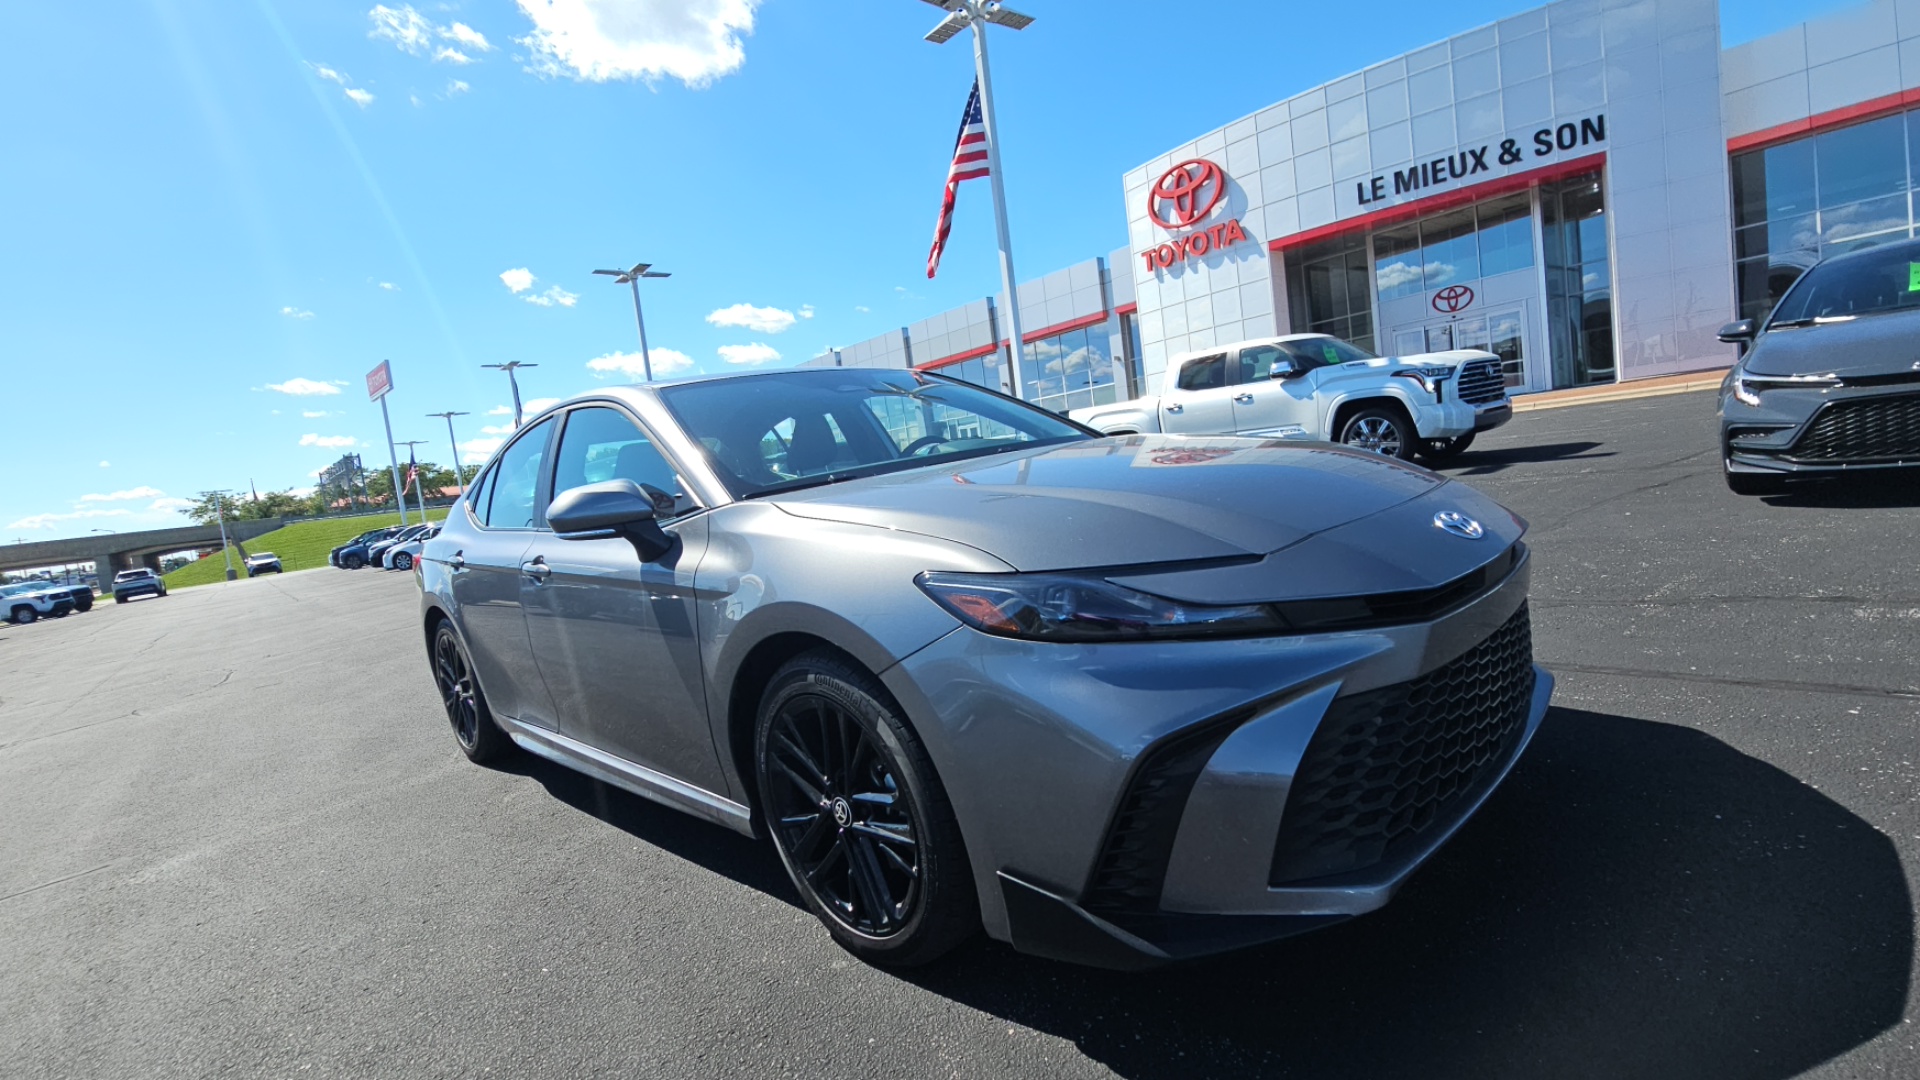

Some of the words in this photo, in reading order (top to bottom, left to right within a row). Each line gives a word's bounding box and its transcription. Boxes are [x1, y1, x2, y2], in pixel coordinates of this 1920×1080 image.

[1357, 176, 1386, 205] LE
[1393, 145, 1489, 195] MIEUX
[1498, 138, 1523, 165] &
[1533, 114, 1606, 157] SON
[1141, 218, 1247, 273] TOYOTA
